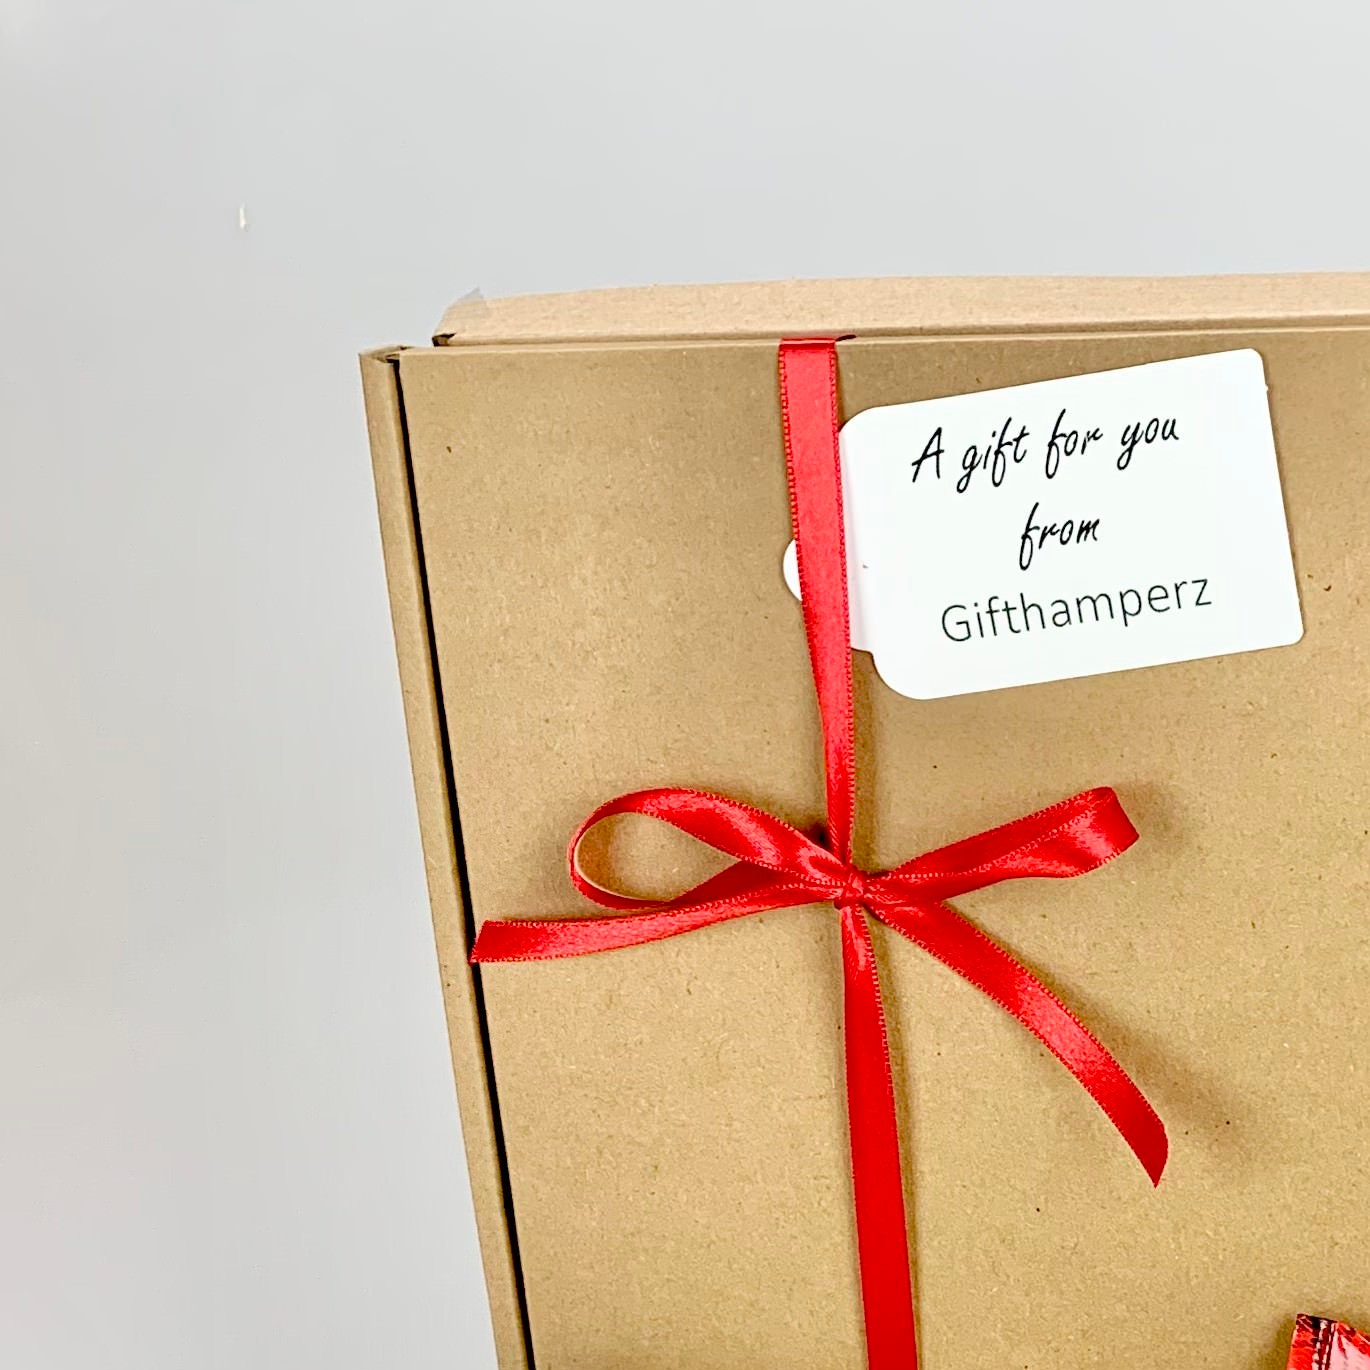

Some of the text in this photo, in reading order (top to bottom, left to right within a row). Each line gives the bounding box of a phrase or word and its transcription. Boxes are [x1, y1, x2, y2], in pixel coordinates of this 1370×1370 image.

[911, 408, 1180, 493] A gift for you
[1018, 501, 1102, 571] from
[940, 576, 1213, 643] Gifthamperz
